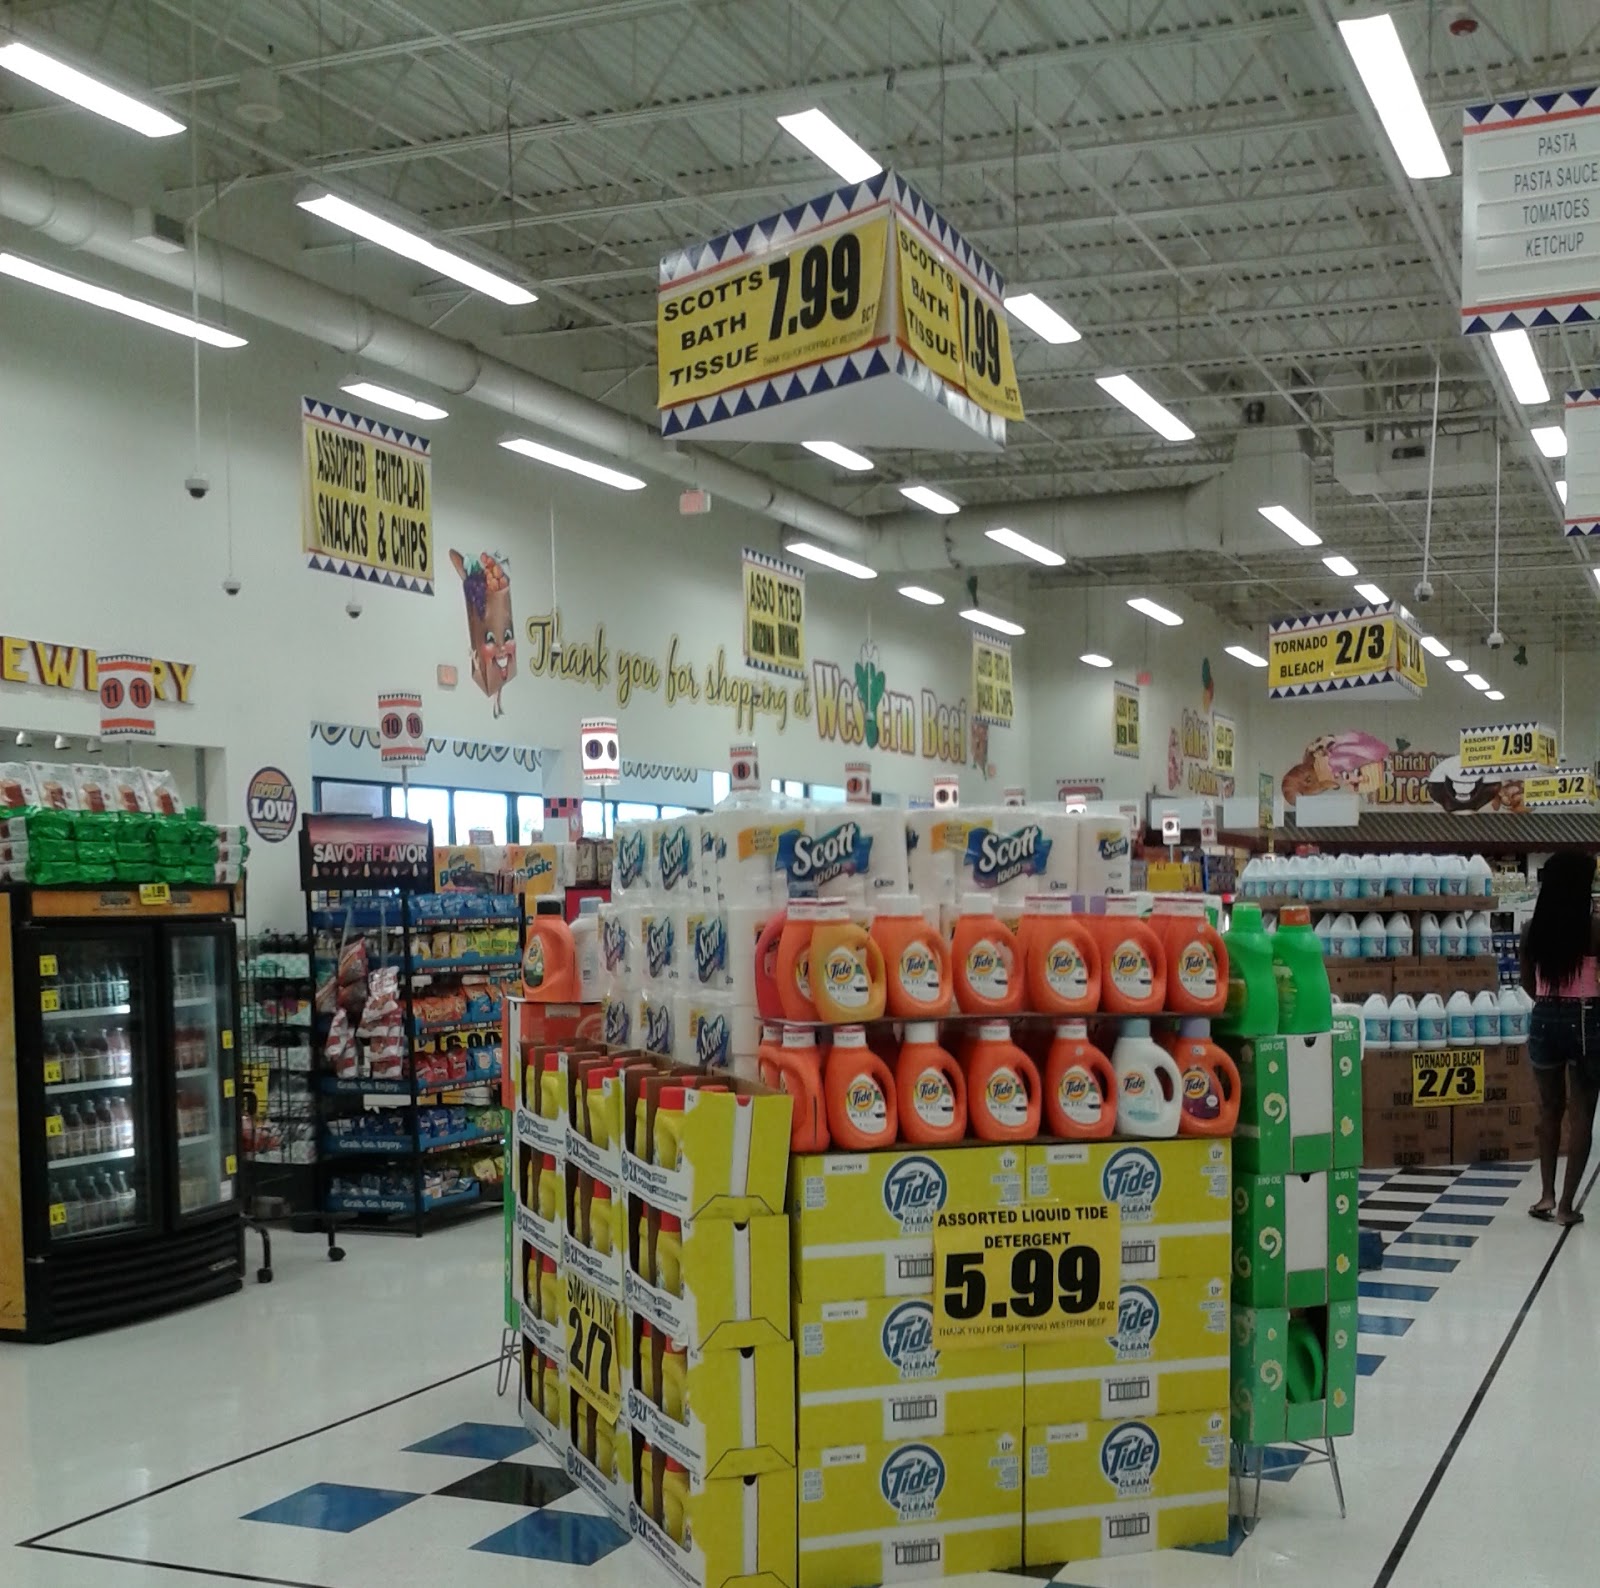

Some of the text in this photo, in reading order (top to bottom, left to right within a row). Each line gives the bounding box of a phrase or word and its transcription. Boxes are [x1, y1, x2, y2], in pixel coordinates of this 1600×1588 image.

[1538, 132, 1577, 156] PASTA
[1514, 163, 1598, 193] PASTA SAUCE
[1523, 198, 1590, 224] TOMATOES
[1525, 232, 1584, 257] KETCHUP
[900, 230, 954, 293] SCOTTS
[664, 271, 763, 322] SCOTTS
[769, 233, 860, 341] 7.99
[911, 276, 949, 320] BATH
[681, 311, 746, 350] BATH
[907, 308, 957, 363] TISSUE
[960, 283, 1000, 386] 7.99
[670, 343, 758, 387] TISSUE
[315, 428, 426, 512] ASSORTED FRITO-LAY
[318, 492, 428, 573] SNACKS & CHIPS
[1274, 635, 1328, 654] TORNADO
[1335, 624, 1385, 666] 2/3
[527, 611, 609, 687] Thank
[617, 650, 658, 706] you
[666, 635, 699, 705] for
[706, 647, 787, 732] shopping
[793, 678, 812, 720] at
[1280, 660, 1324, 678] BLEACH
[103, 683, 119, 702] 11
[384, 717, 400, 735] 10
[409, 717, 421, 735] 10
[921, 688, 967, 765] Beef
[1464, 736, 1499, 744] ASSORTED
[1502, 732, 1533, 755] 7.99
[1394, 753, 1426, 772] Brick
[1558, 777, 1585, 794] 3/2
[251, 797, 294, 823] LOW
[313, 843, 365, 863] SAVOR
[373, 844, 427, 863] FLAVOR
[793, 821, 857, 877] Scott
[979, 825, 1038, 873] Scott
[997, 864, 1021, 884] 1000
[831, 961, 852, 979] Tide
[906, 957, 926, 972] Tide
[973, 954, 994, 970] Tide
[1052, 956, 1073, 973] Tide
[1117, 954, 1138, 971] Tide
[1184, 956, 1204, 972] Tide
[1414, 1051, 1481, 1069] TORNADO BLEACH
[920, 1082, 940, 1098] Tide
[992, 1081, 1013, 1097] Tide
[1065, 1080, 1086, 1096] Tide
[1124, 1076, 1145, 1091] Tide
[1184, 1077, 1206, 1093] Tide
[1418, 1067, 1476, 1097] 2/3
[852, 1090, 872, 1106] Tide
[1110, 1161, 1155, 1200] Tide
[890, 1170, 941, 1215] Tide
[938, 1210, 1017, 1227] ASSORTED
[1022, 1207, 1071, 1223] LIQUID
[1075, 1206, 1108, 1220] TIDE
[1121, 1204, 1151, 1213] CLEAN
[984, 1232, 1071, 1249] DETERGENT
[944, 1245, 1100, 1319] 5.99
[568, 1271, 595, 1318] SIMPLY
[939, 1316, 1107, 1336] THANK YOU FOR SHOPPING WESTERN BEEF
[1119, 1343, 1150, 1351] CLEAN
[902, 1361, 936, 1370] CLEAN
[1211, 1420, 1221, 1429] UP
[1109, 1436, 1153, 1477] Tide
[888, 1458, 939, 1502] Tide
[1119, 1478, 1150, 1487] CLEAN
[902, 1502, 935, 1512] CLEAN
